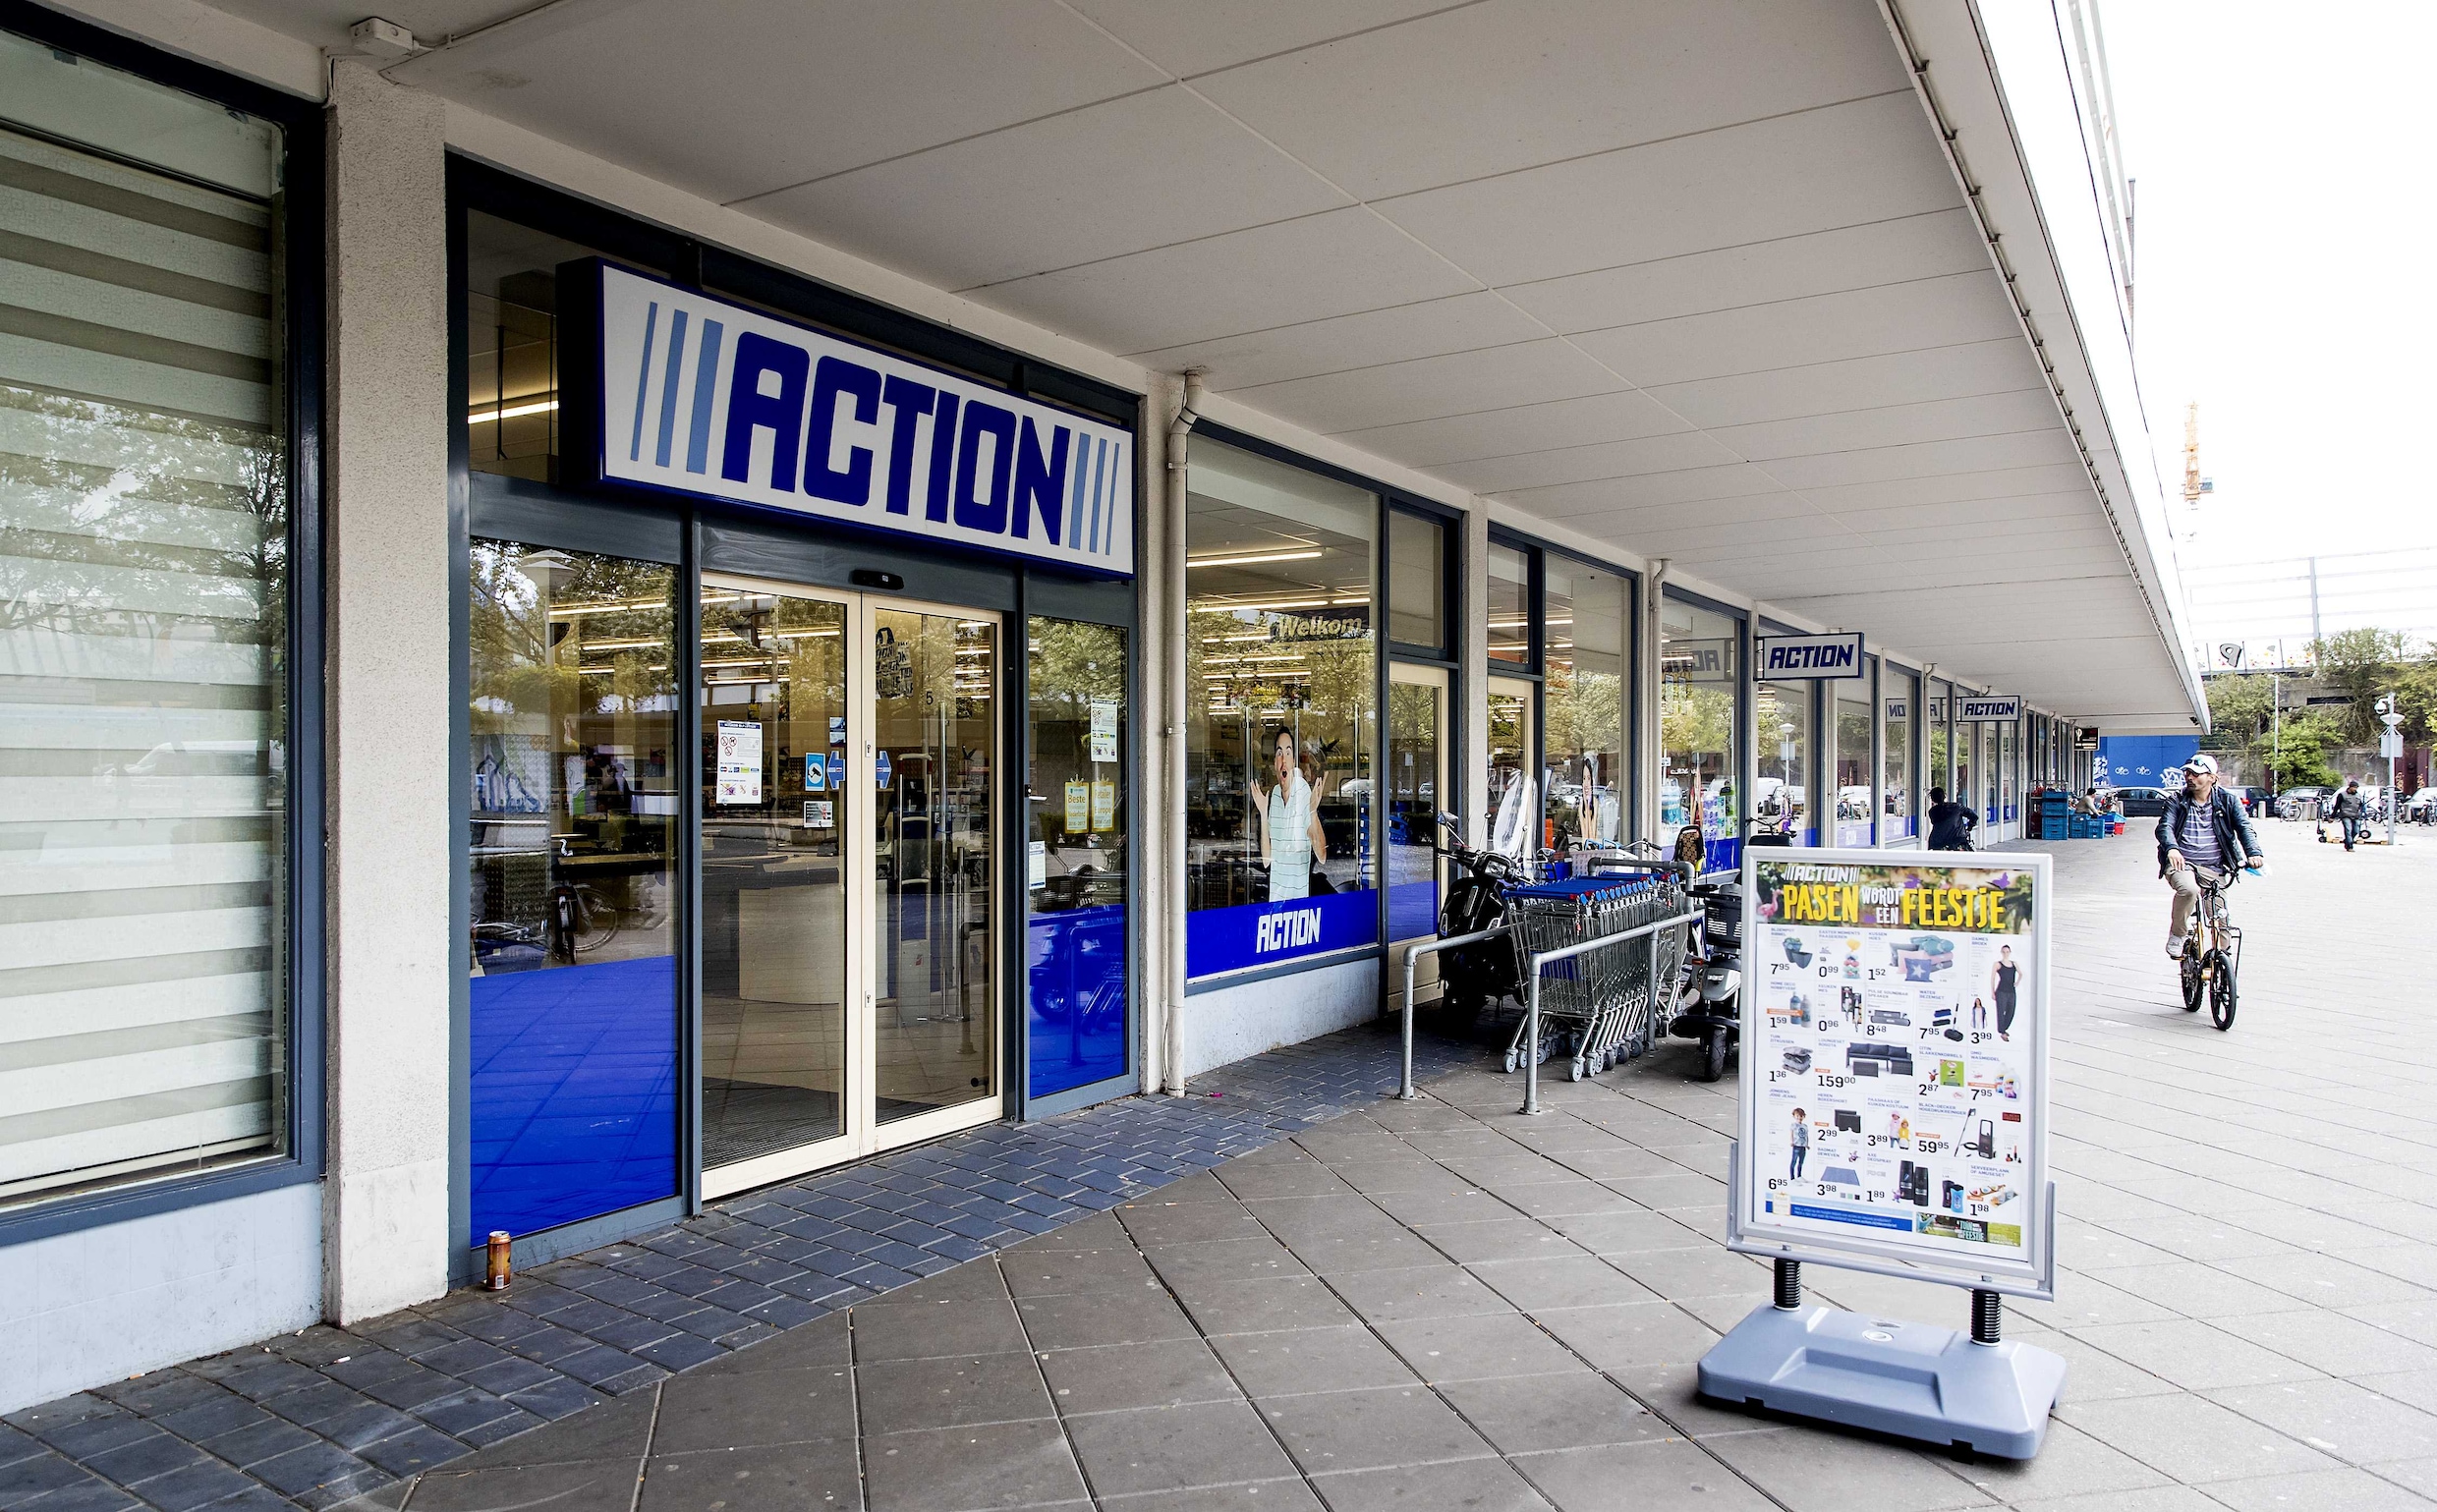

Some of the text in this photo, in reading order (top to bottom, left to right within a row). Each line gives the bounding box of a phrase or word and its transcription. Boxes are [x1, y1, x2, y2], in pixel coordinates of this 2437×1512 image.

[721, 331, 1070, 546] ACTION
[1278, 615, 1362, 638] Welkom
[1769, 644, 1854, 669] ACTION
[926, 691, 934, 705] 5
[1964, 701, 2015, 716] ACTION
[1793, 866, 1850, 882] ACTION
[1783, 884, 1859, 924] PASEN
[1862, 887, 1900, 907] WORDT
[1902, 887, 2007, 928] FEESTJE
[1256, 907, 1322, 953] ACTION
